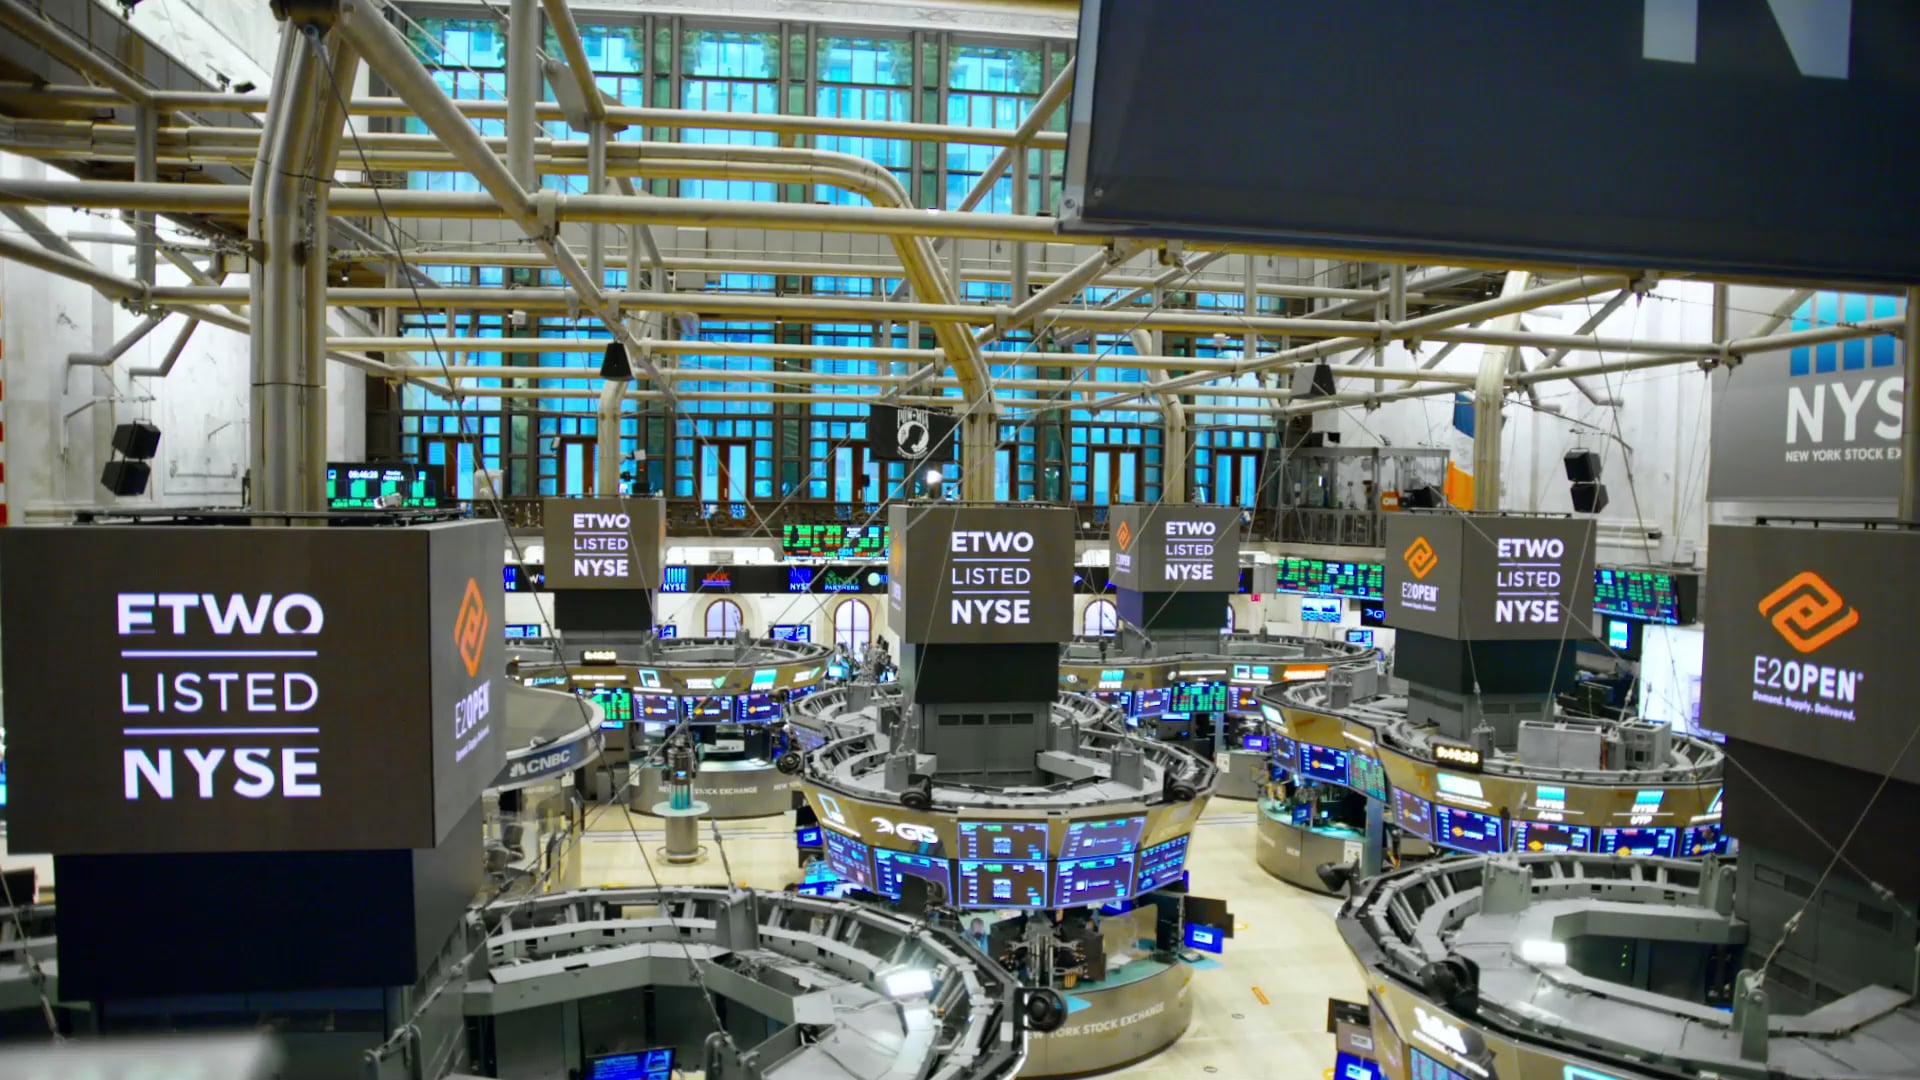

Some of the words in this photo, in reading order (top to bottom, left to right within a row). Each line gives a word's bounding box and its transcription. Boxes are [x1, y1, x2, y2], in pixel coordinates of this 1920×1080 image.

[1785, 450, 1809, 462] NEW
[1812, 449, 1842, 461] YORK
[1845, 448, 1884, 460] STOCK
[573, 513, 630, 528] ETWO
[1165, 521, 1216, 535] ETWO
[574, 538, 628, 550] LISTED
[951, 531, 1034, 552] ETWO
[1166, 544, 1214, 555] LISTED
[1497, 537, 1564, 558] ETWO
[574, 559, 629, 577] NYSE
[952, 568, 1031, 584] LISTED
[1165, 564, 1213, 580] NYSE
[662, 583, 687, 591] NYSE
[1497, 571, 1561, 588] LISTED
[1401, 581, 1438, 602] E2OPEN
[117, 593, 324, 635] ETWO
[951, 599, 1031, 625] NYSE
[1495, 600, 1560, 623] NYSE
[1754, 655, 1857, 703] E2OPEN
[121, 672, 319, 713] LISTED
[526, 749, 571, 773] CNBC
[123, 748, 322, 799] NYSE
[719, 786, 758, 795] EXCHANGE
[1082, 1019, 1119, 1035] STOCK
[1119, 1001, 1165, 1027] EXCHANGE
